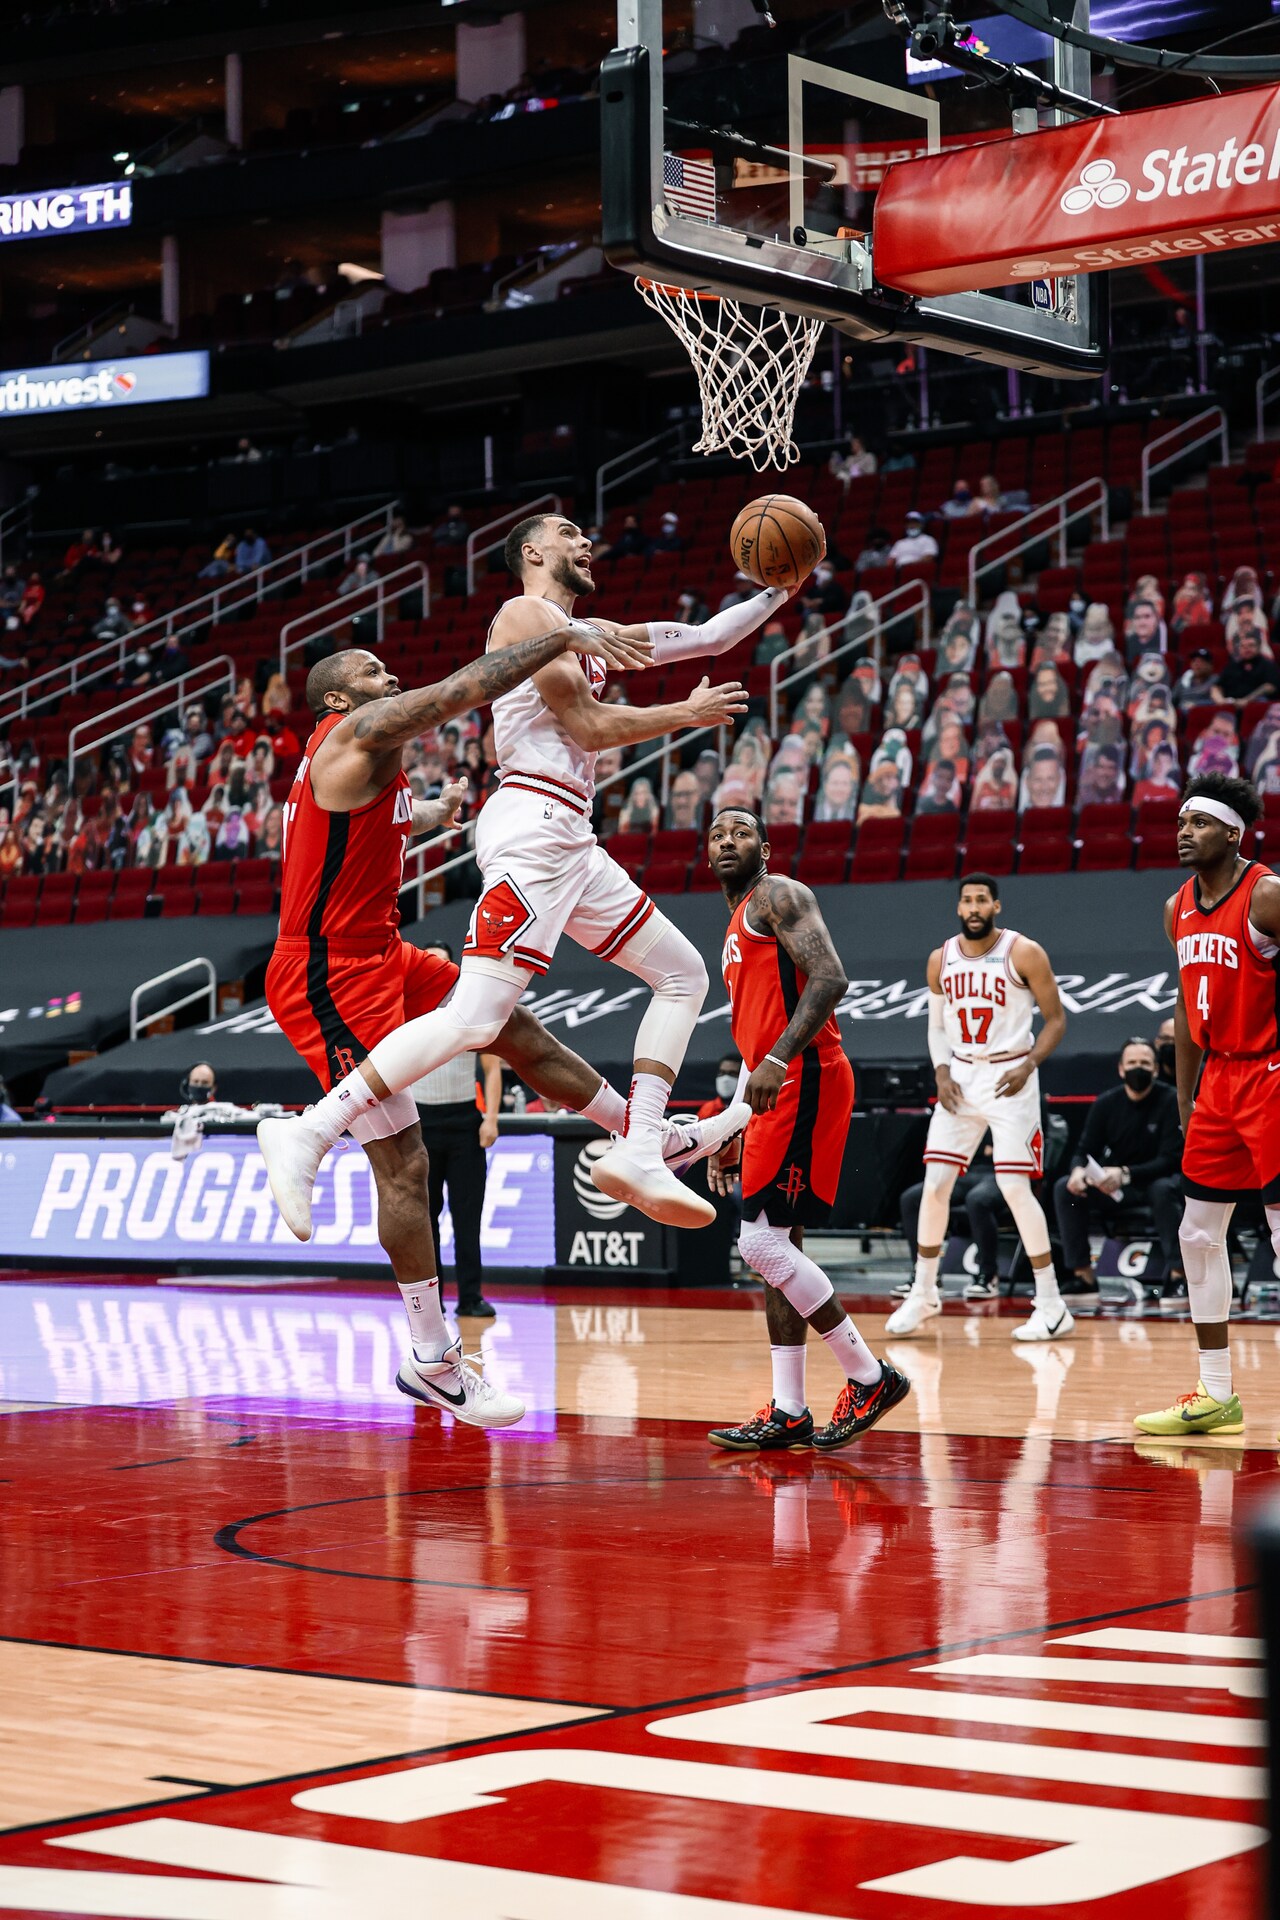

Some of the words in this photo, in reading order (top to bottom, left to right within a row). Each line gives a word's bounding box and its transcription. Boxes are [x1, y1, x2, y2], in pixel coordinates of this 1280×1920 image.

[0, 195, 74, 235] RING
[1073, 223, 1280, 266] StateFar
[1035, 286, 1048, 305] NBA
[1177, 932, 1239, 971] ROCKETS
[944, 971, 1006, 1007] BULLS
[1196, 975, 1210, 1021] 4
[957, 1007, 994, 1045] 17
[31, 1152, 535, 1246] PROGRSE
[568, 1230, 645, 1267] AT&T
